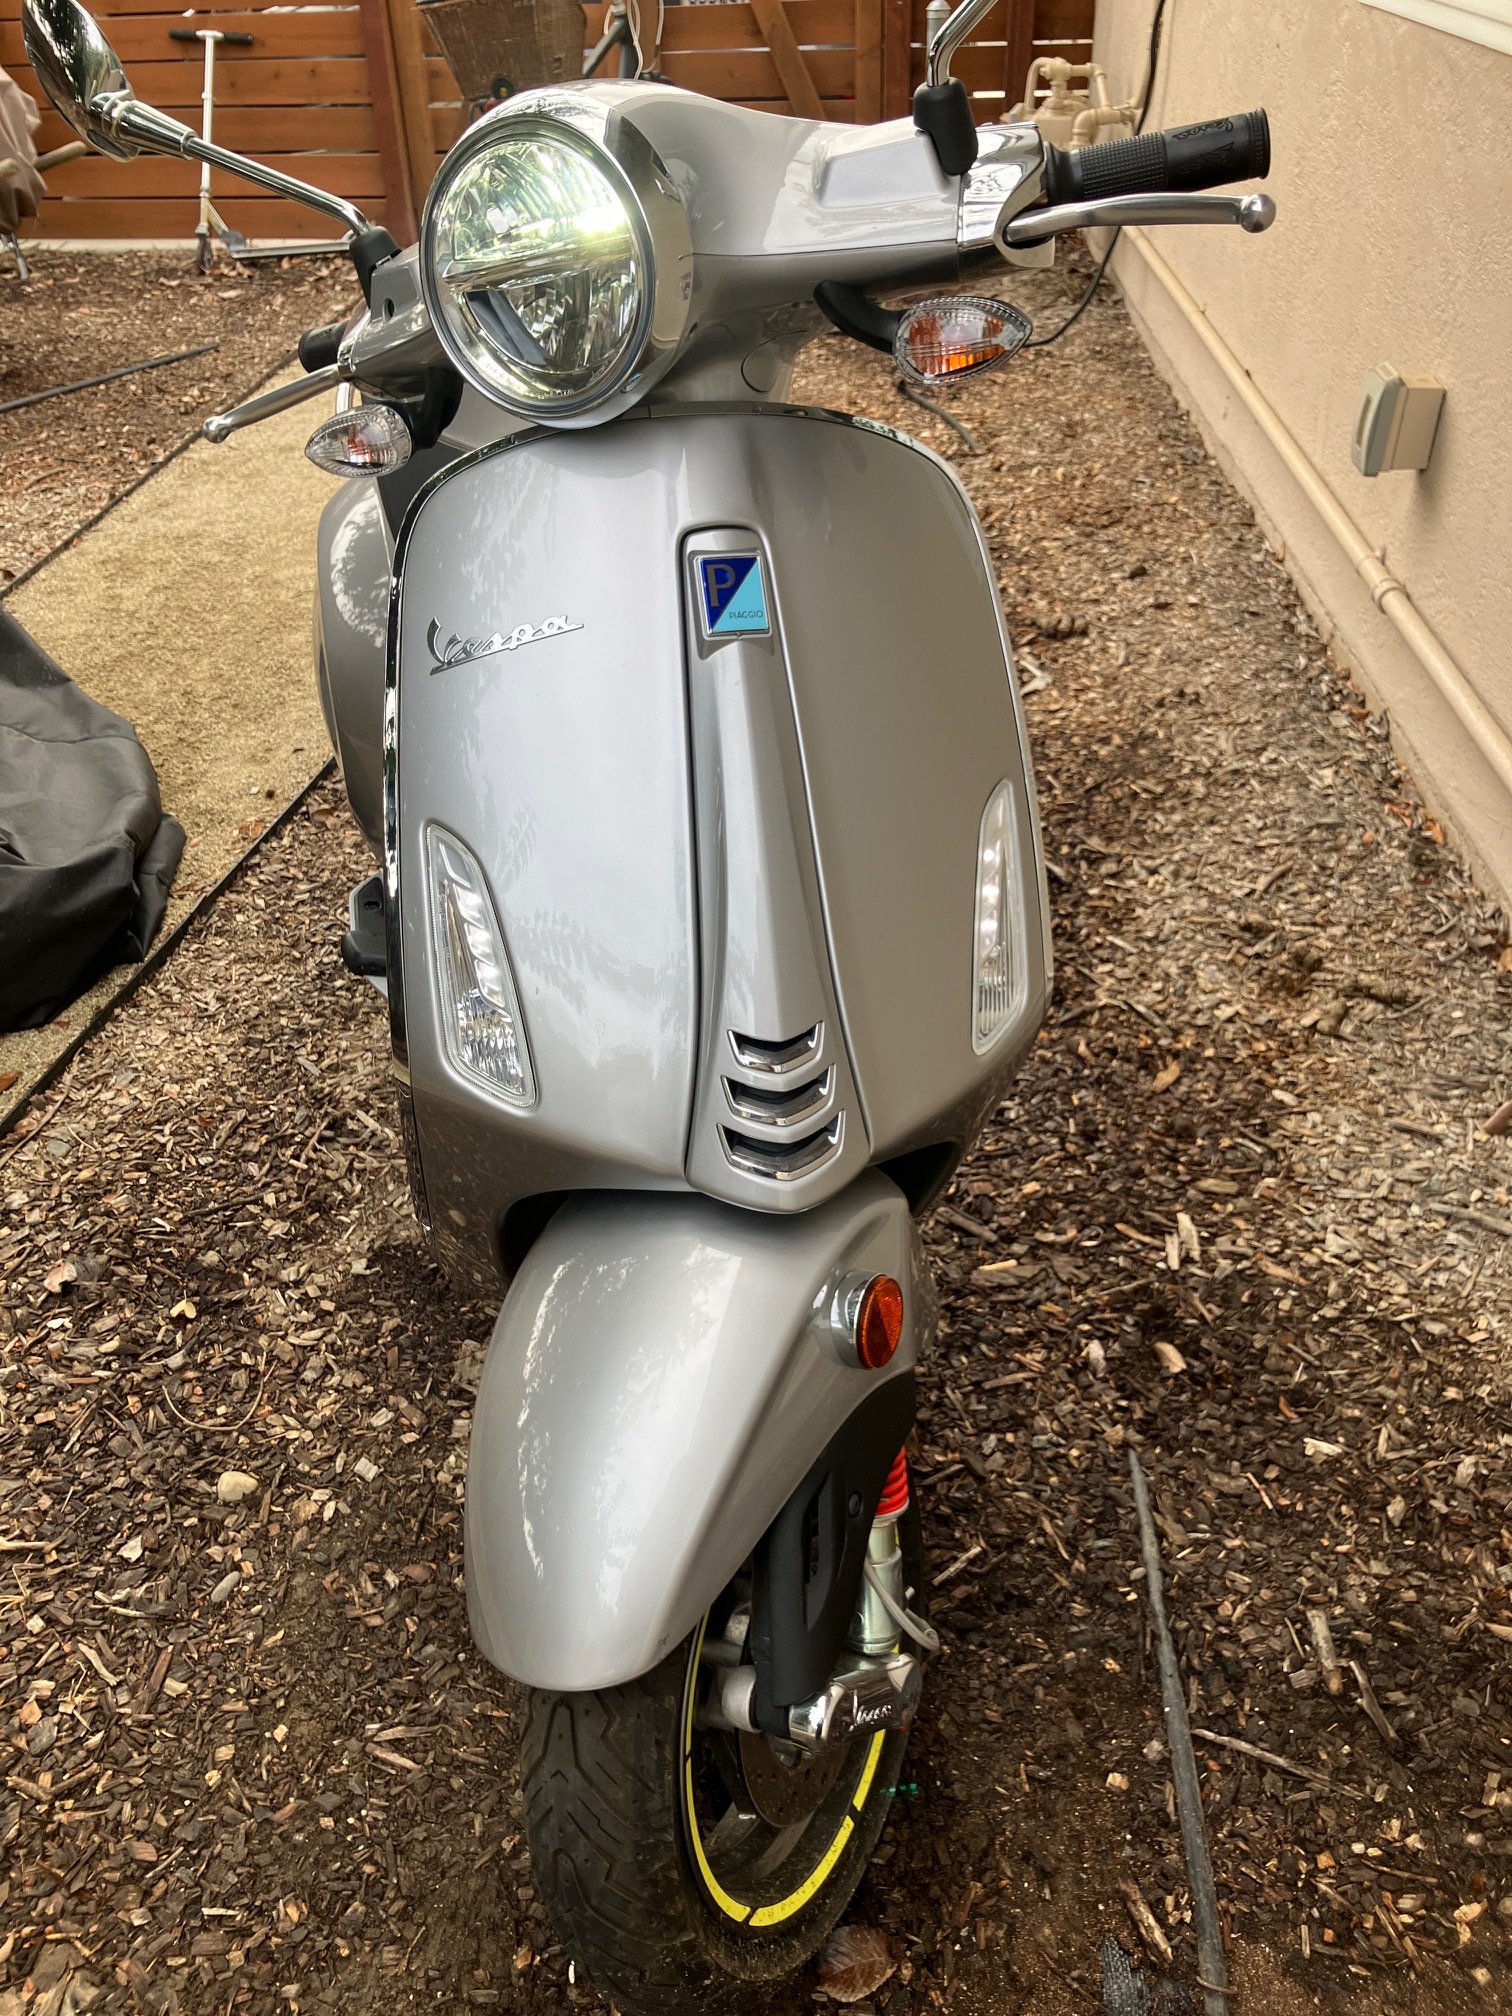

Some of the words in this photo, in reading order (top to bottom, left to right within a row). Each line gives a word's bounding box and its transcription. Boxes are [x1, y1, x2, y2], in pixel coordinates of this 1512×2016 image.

[705, 564, 736, 607] P
[728, 610, 764, 619] PIAGGIO
[427, 615, 585, 676] Vespa
